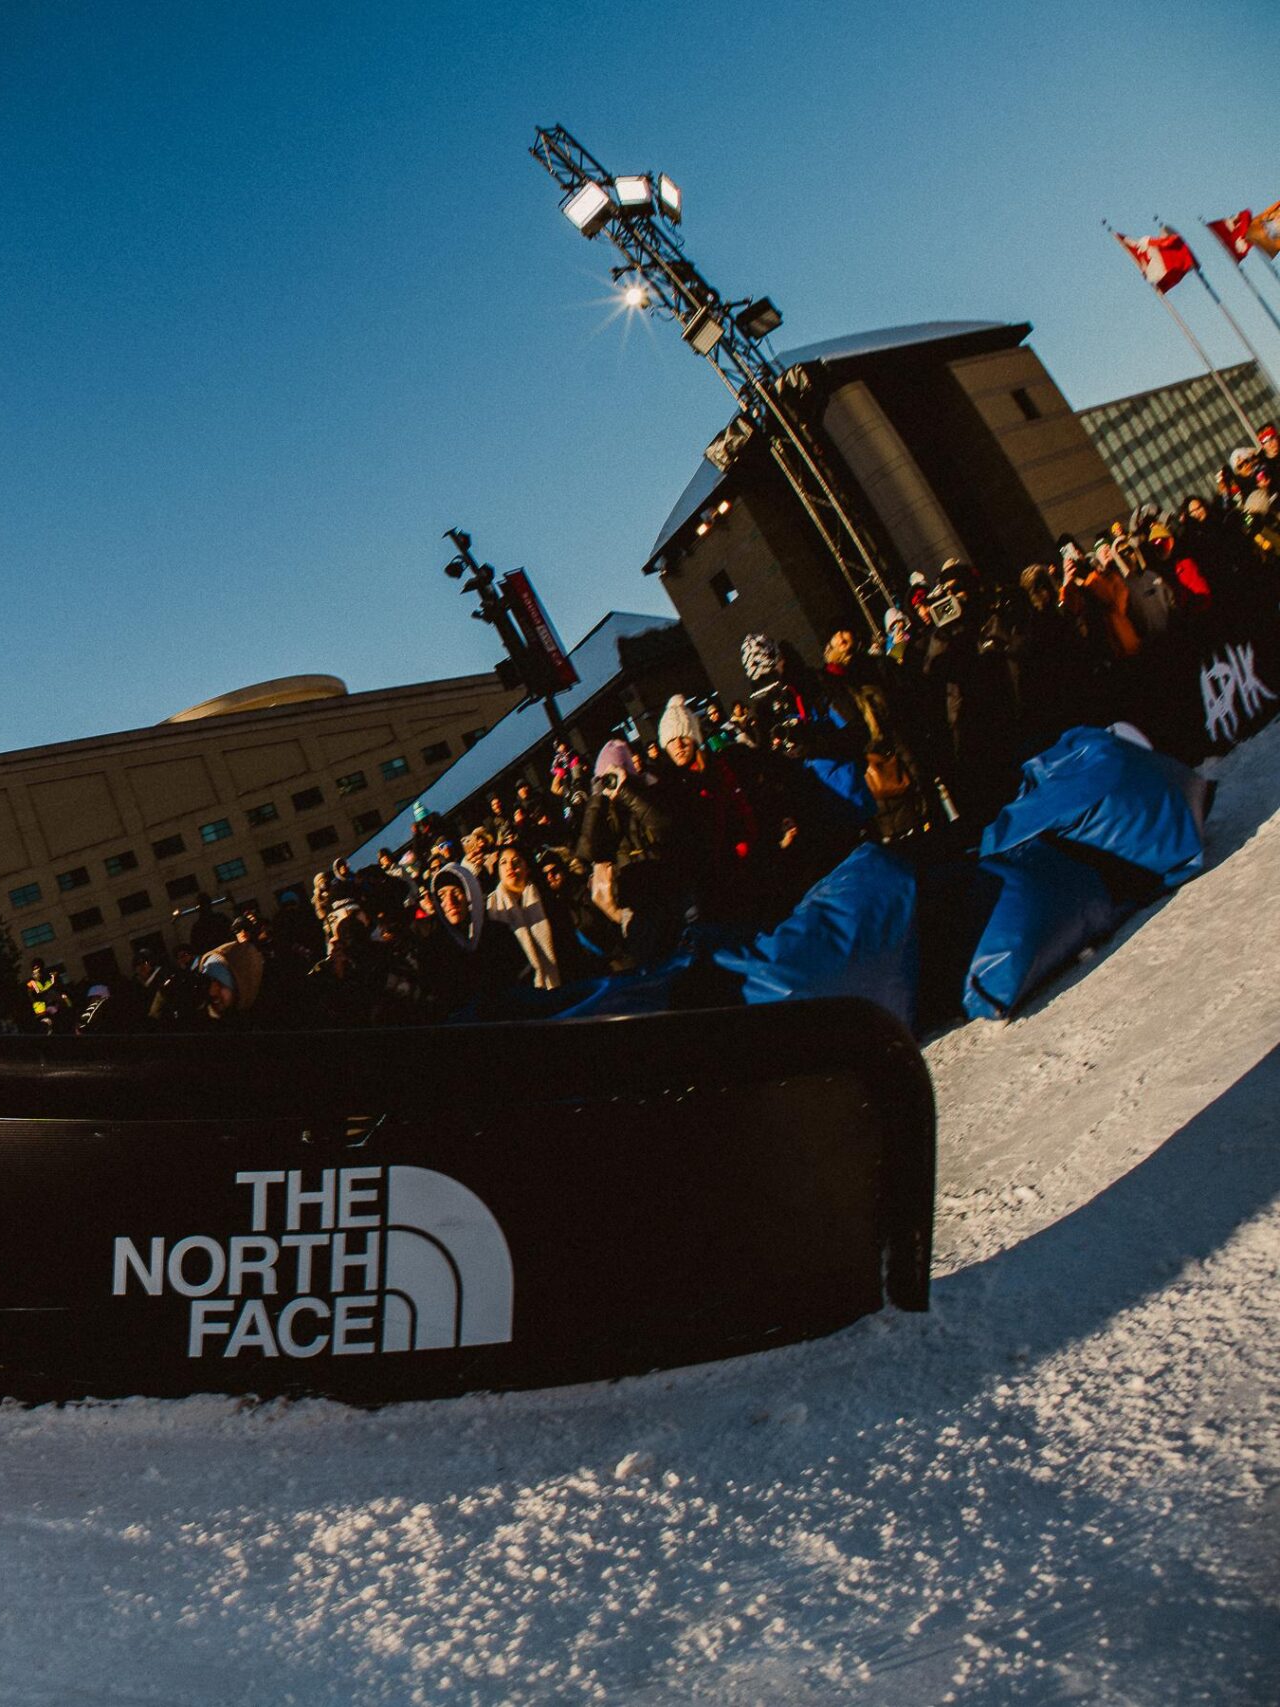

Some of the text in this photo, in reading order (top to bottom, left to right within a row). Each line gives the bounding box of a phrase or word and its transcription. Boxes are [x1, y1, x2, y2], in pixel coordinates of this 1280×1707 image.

[236, 1165, 383, 1232] THE
[112, 1231, 381, 1298] NORTH
[187, 1294, 379, 1359] FACE
